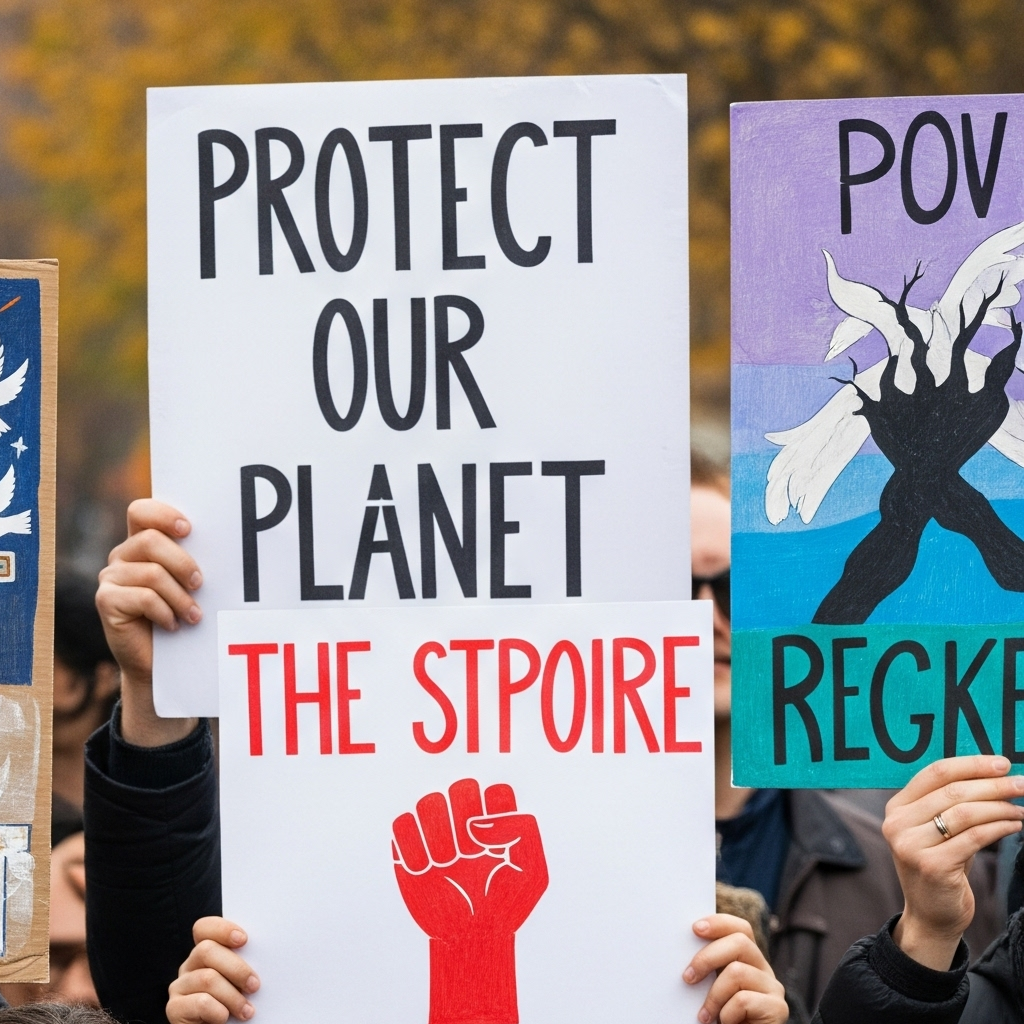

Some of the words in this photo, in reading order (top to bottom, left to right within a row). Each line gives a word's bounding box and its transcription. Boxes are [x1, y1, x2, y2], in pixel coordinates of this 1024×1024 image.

[197, 119, 617, 279] PROTECT
[839, 110, 1008, 235] POV
[312, 295, 497, 432] OUR
[240, 459, 605, 602] PLANET
[228, 641, 376, 756] THE
[412, 636, 703, 754] STPOIRE
